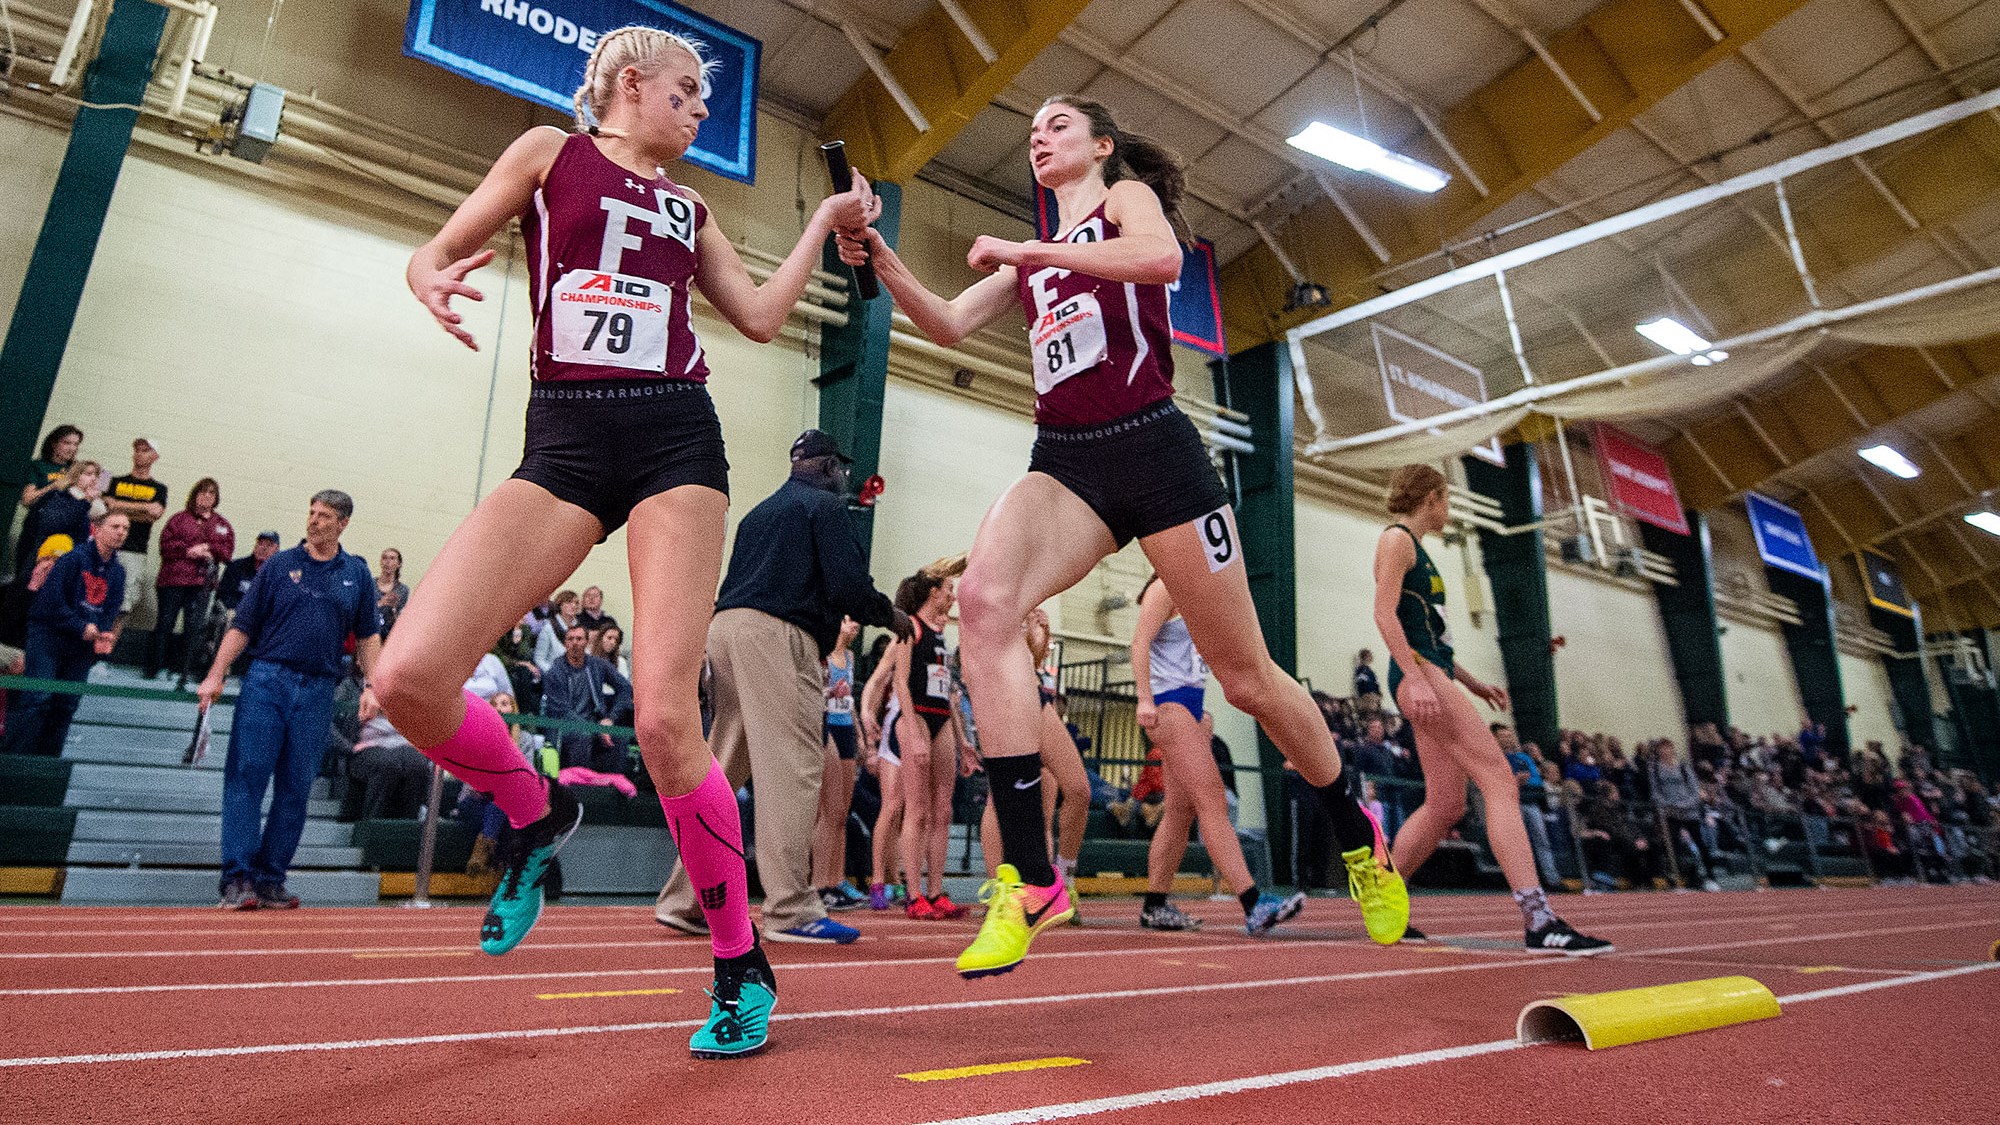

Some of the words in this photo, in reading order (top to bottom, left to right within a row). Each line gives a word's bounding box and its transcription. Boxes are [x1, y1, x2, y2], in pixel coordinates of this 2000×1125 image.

[598, 196, 669, 273] F
[664, 197, 692, 241] 9
[560, 292, 662, 313] CHAMPIONSHIPS
[578, 272, 651, 298] A10
[582, 309, 633, 354] 79
[1039, 301, 1079, 333] A10
[1047, 331, 1076, 373] 81
[606, 383, 674, 399] ARMOUR
[1204, 511, 1232, 563] 9
